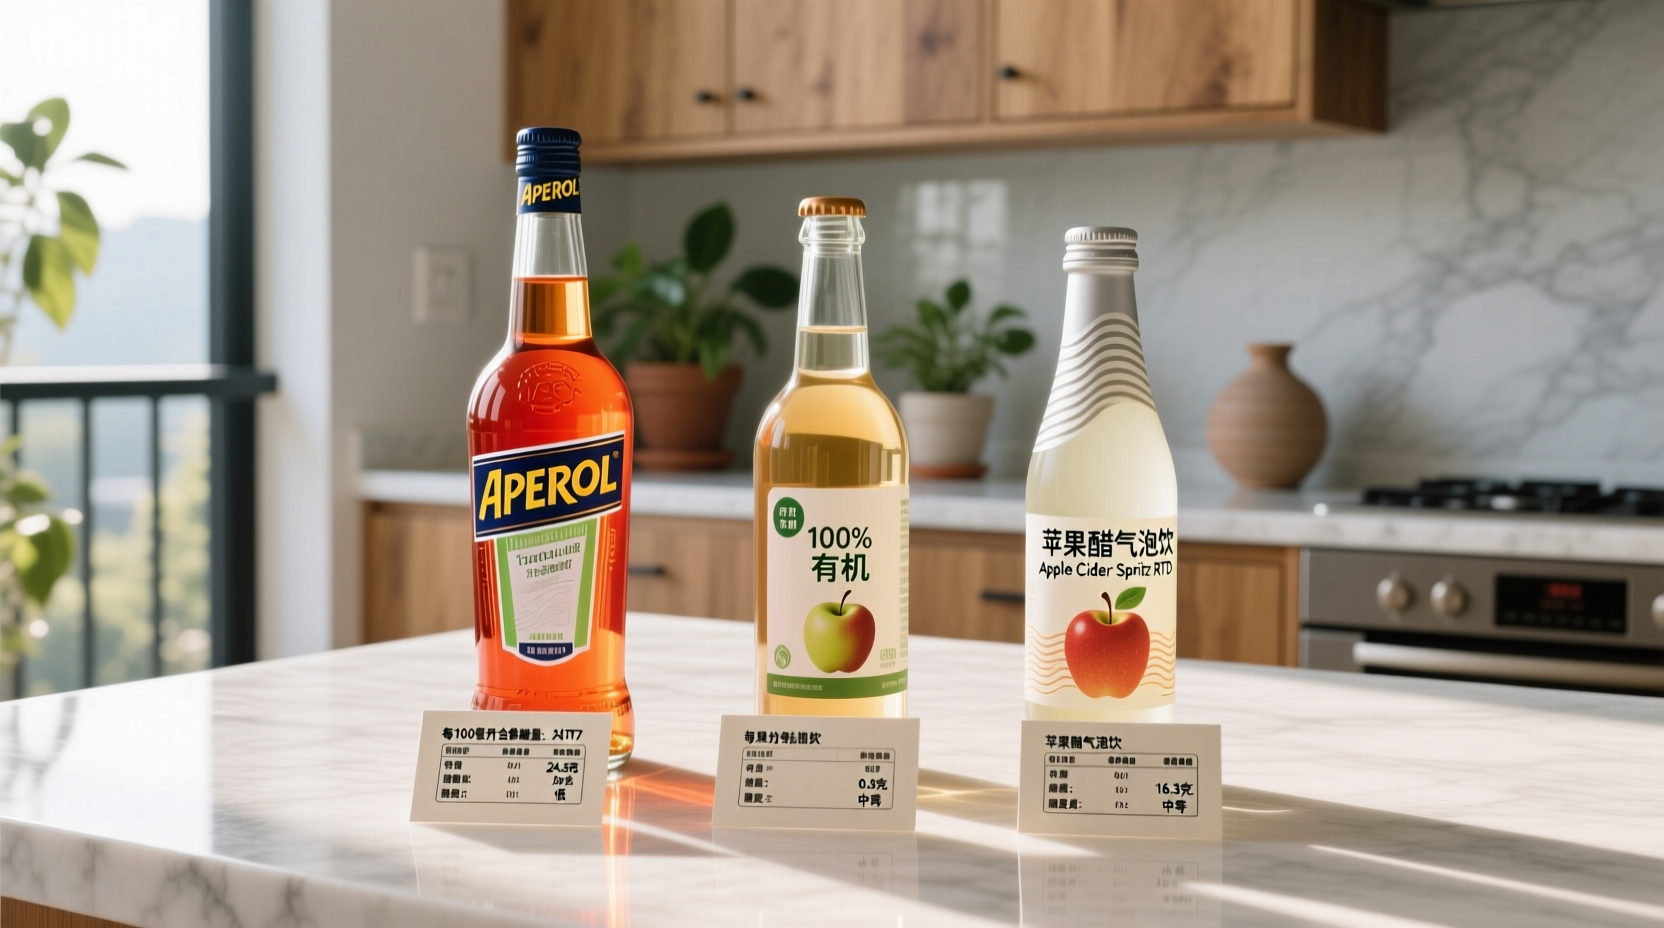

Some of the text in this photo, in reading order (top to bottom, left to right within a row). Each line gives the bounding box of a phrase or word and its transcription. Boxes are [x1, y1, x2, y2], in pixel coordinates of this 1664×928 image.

[520, 178, 580, 207] APEROL
[478, 454, 617, 521] APEROL
[807, 526, 872, 549] 100%
[1042, 527, 1174, 558] 苹果醋气泡饮
[811, 552, 870, 583] 有机
[1038, 561, 1073, 580] Apple
[1076, 561, 1113, 577] Cider
[1153, 560, 1173, 577] RTD
